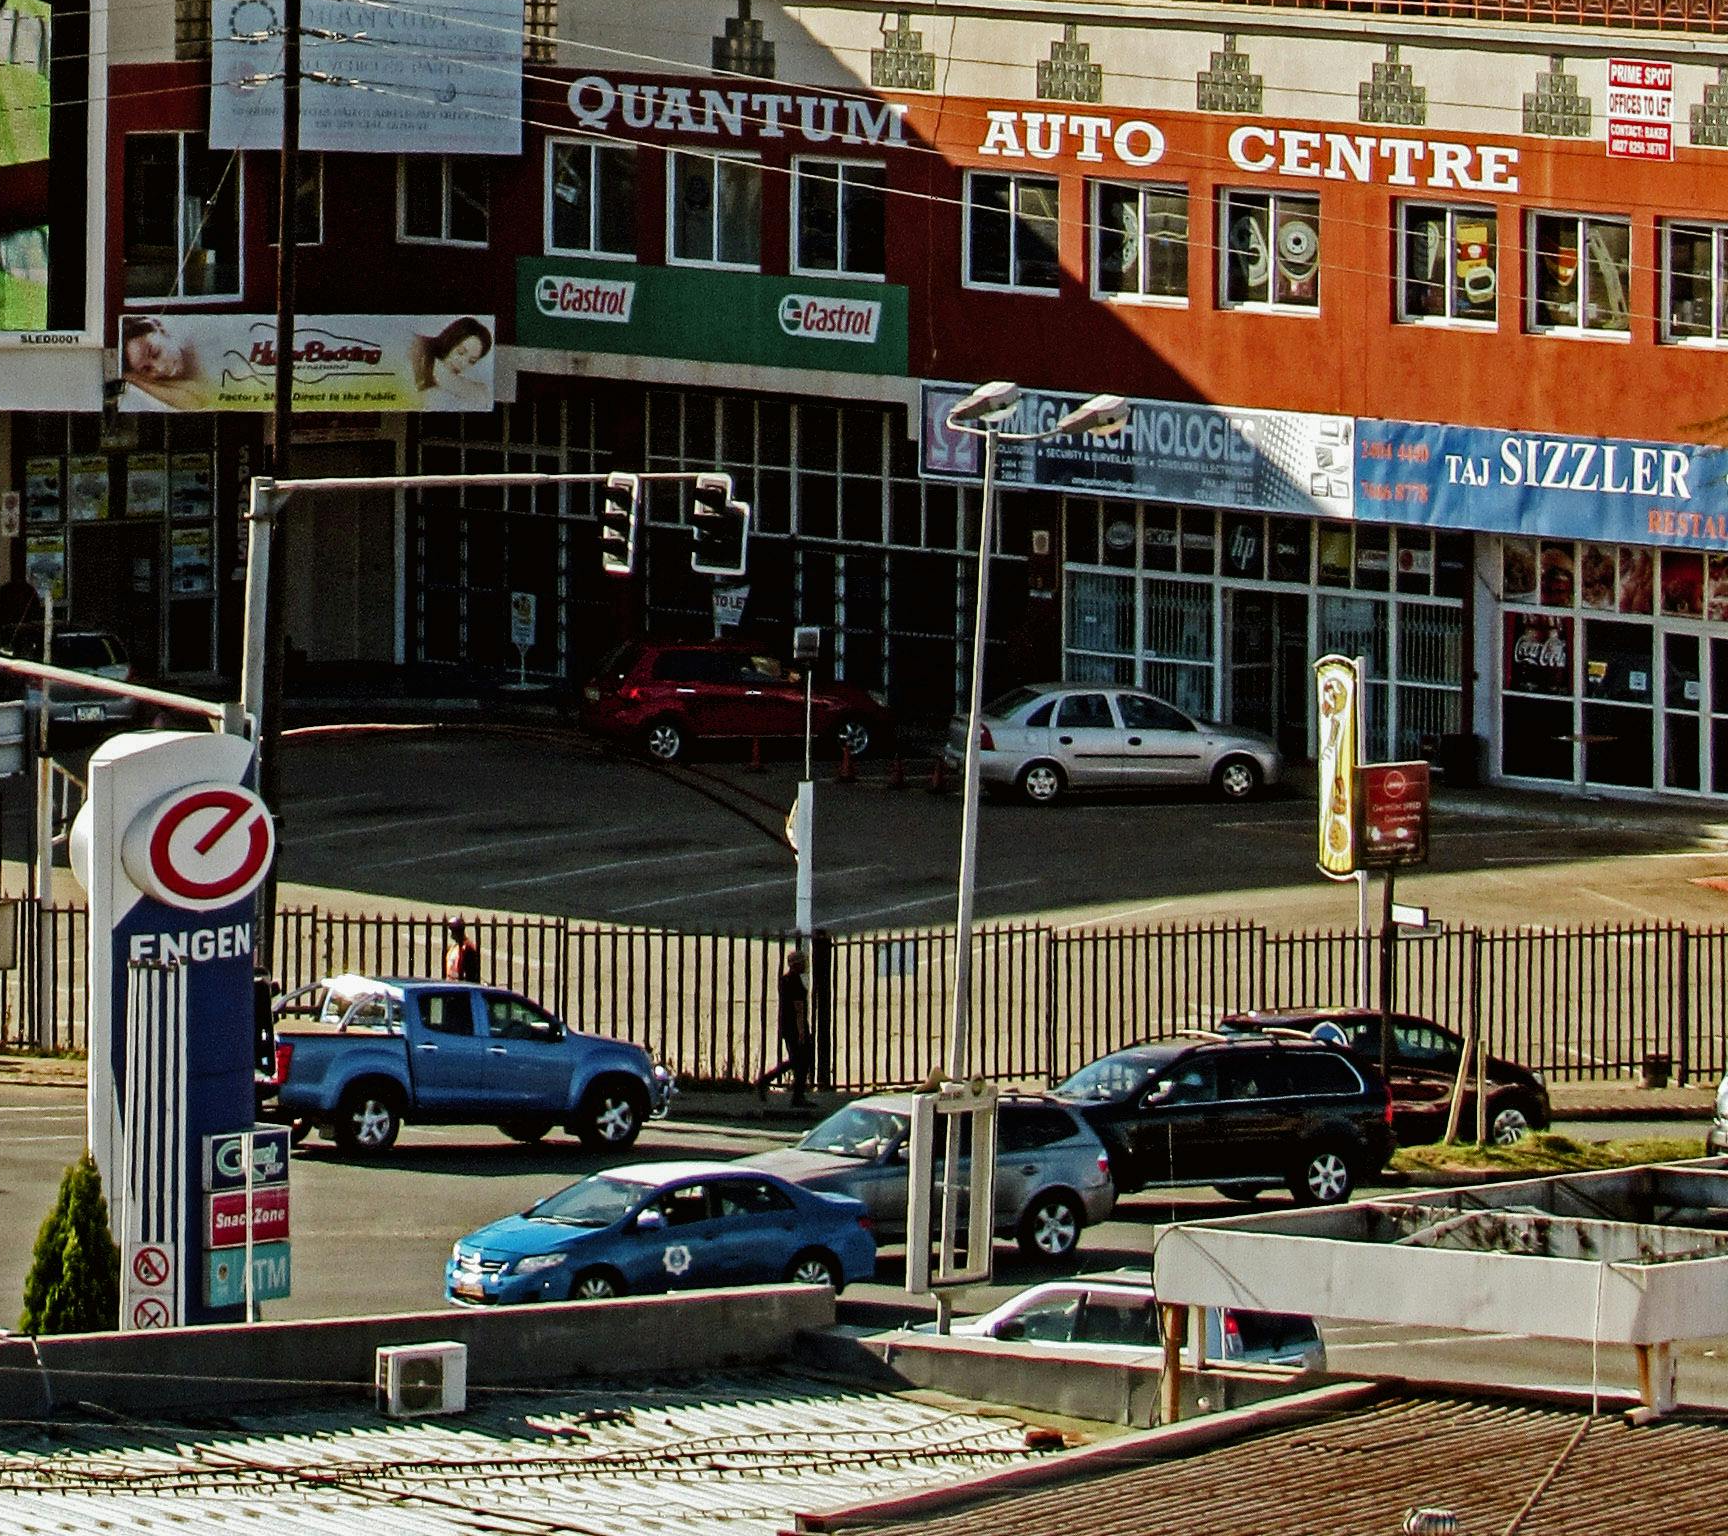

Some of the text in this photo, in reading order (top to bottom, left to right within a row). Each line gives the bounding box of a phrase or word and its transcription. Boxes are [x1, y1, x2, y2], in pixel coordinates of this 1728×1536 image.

[1610, 64, 1671, 87] PRIME SPOT
[1609, 93, 1672, 117] OFFICES TO LET
[567, 75, 1519, 193] QUANTUM AUTO CENTRE
[559, 281, 626, 316] Castrol
[803, 301, 872, 336] Castrol
[218, 392, 259, 403] Factory
[292, 392, 326, 402] Direct
[342, 392, 361, 402] the
[363, 392, 397, 402] Public
[994, 398, 1075, 445] MEGA
[1045, 448, 1083, 460] SECURITY
[1445, 437, 1692, 500] TAJ SIZZLER
[1233, 525, 1256, 571] hp
[130, 922, 251, 966] ENGEN
